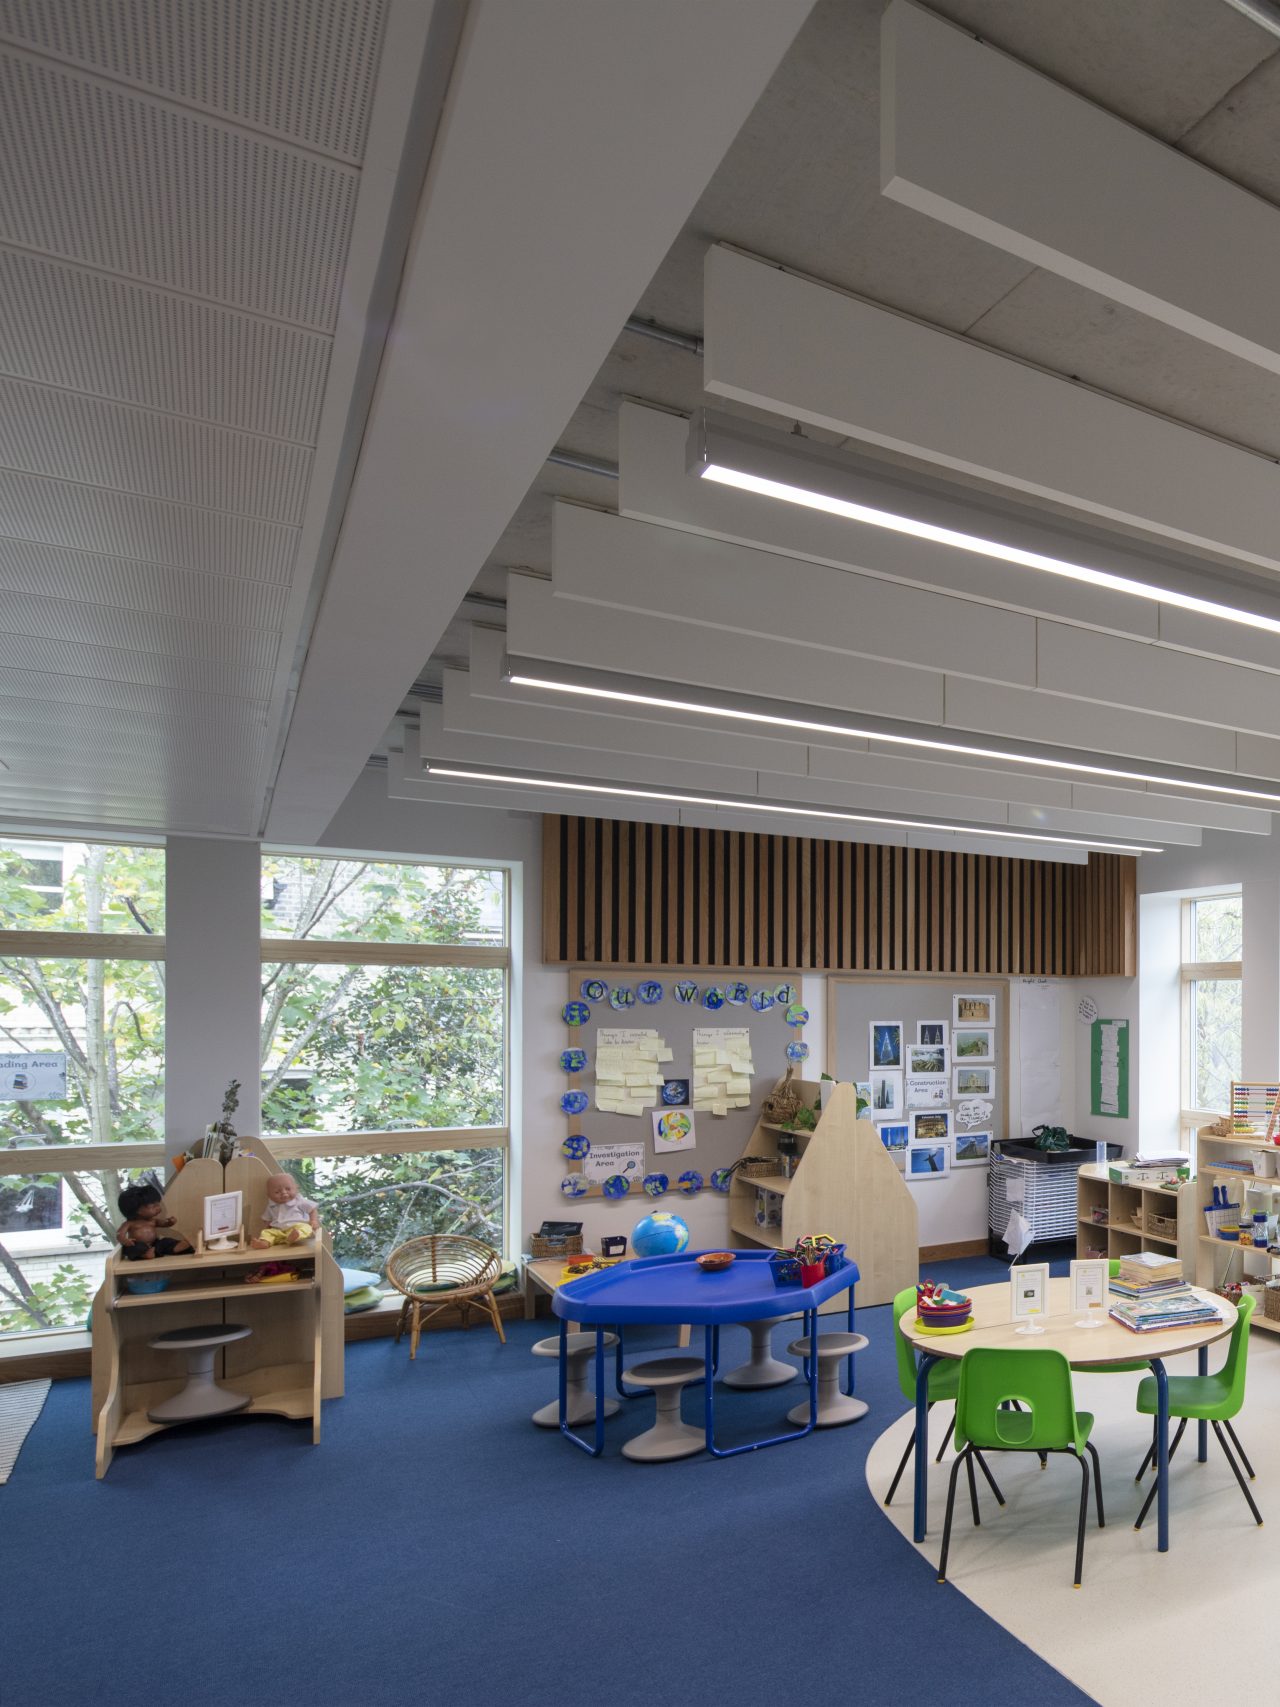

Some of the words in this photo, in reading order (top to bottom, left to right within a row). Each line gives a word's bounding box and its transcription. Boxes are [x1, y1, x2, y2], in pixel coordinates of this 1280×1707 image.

[586, 981, 656, 1005] Our
[31, 1060, 58, 1068] Area
[909, 1079, 947, 1087] Construction
[590, 1150, 640, 1160] Investigation
